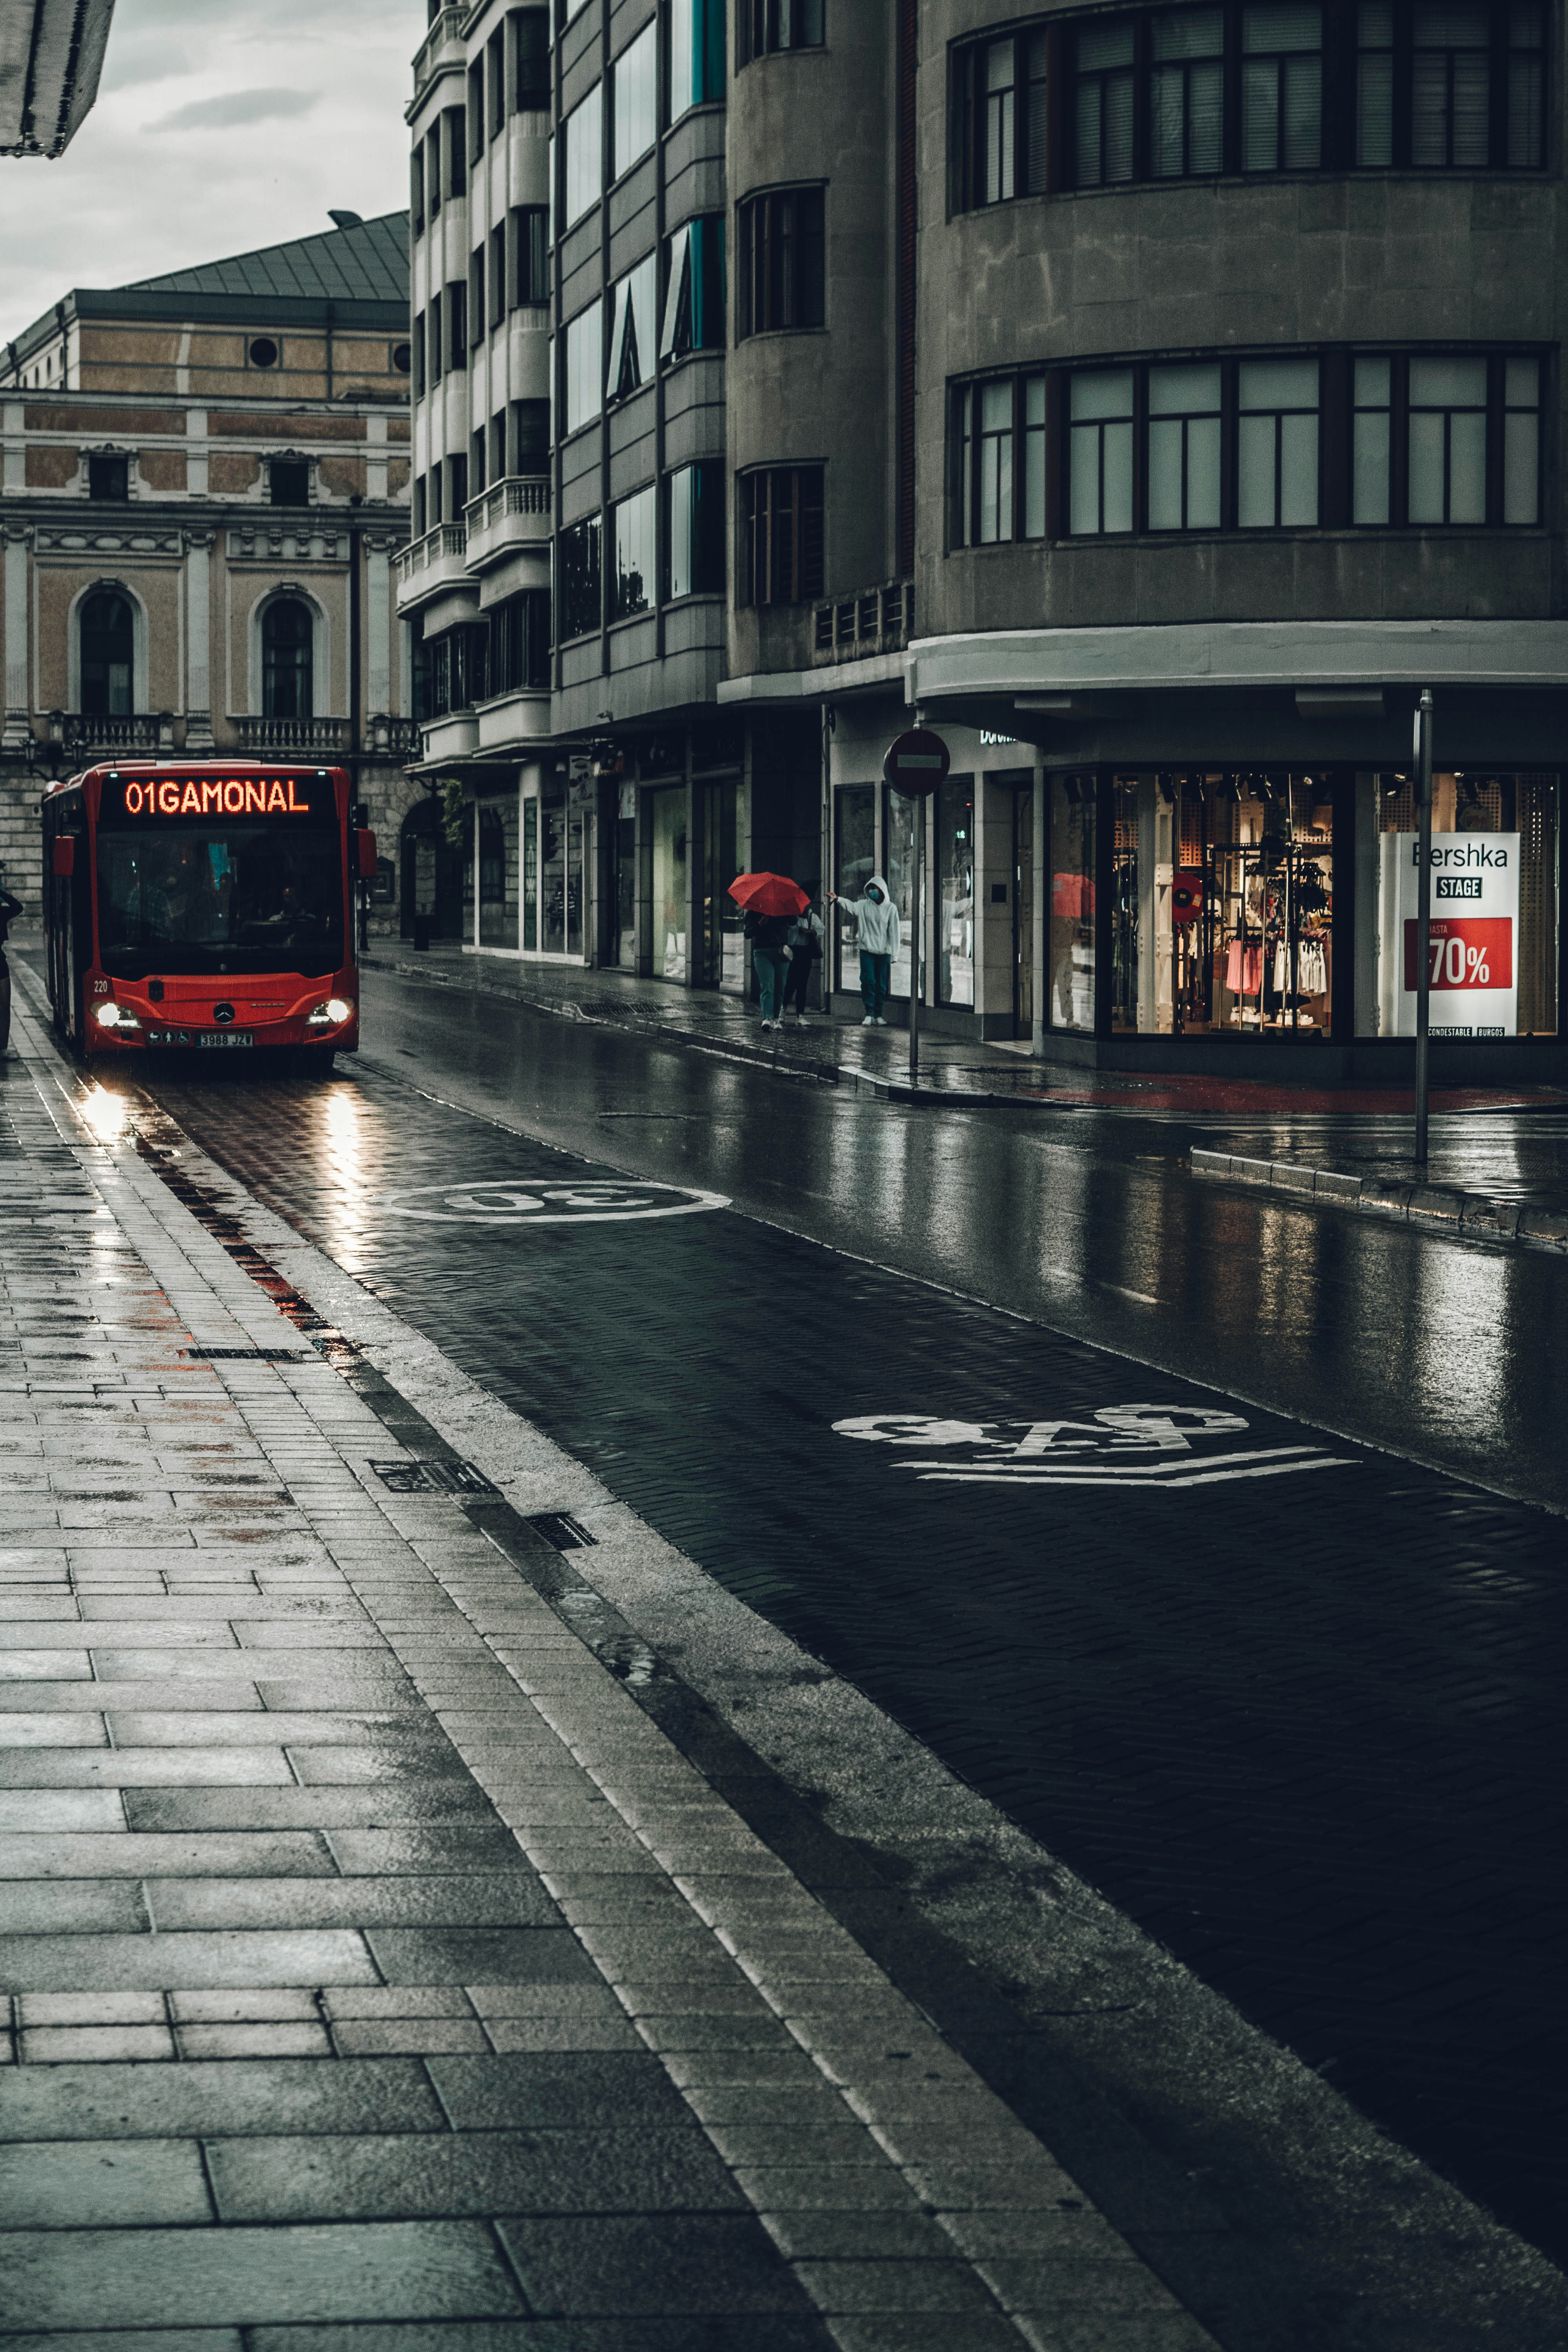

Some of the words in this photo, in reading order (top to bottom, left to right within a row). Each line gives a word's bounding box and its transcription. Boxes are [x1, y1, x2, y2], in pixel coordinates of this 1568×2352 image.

[1440, 879, 1480, 897] STAGE
[1429, 937, 1490, 984] 70%
[94, 980, 108, 993] 220
[1428, 1028, 1471, 1036] CONDESTABLE
[1478, 1028, 1503, 1036] BURGOS
[202, 1035, 228, 1045] 3988
